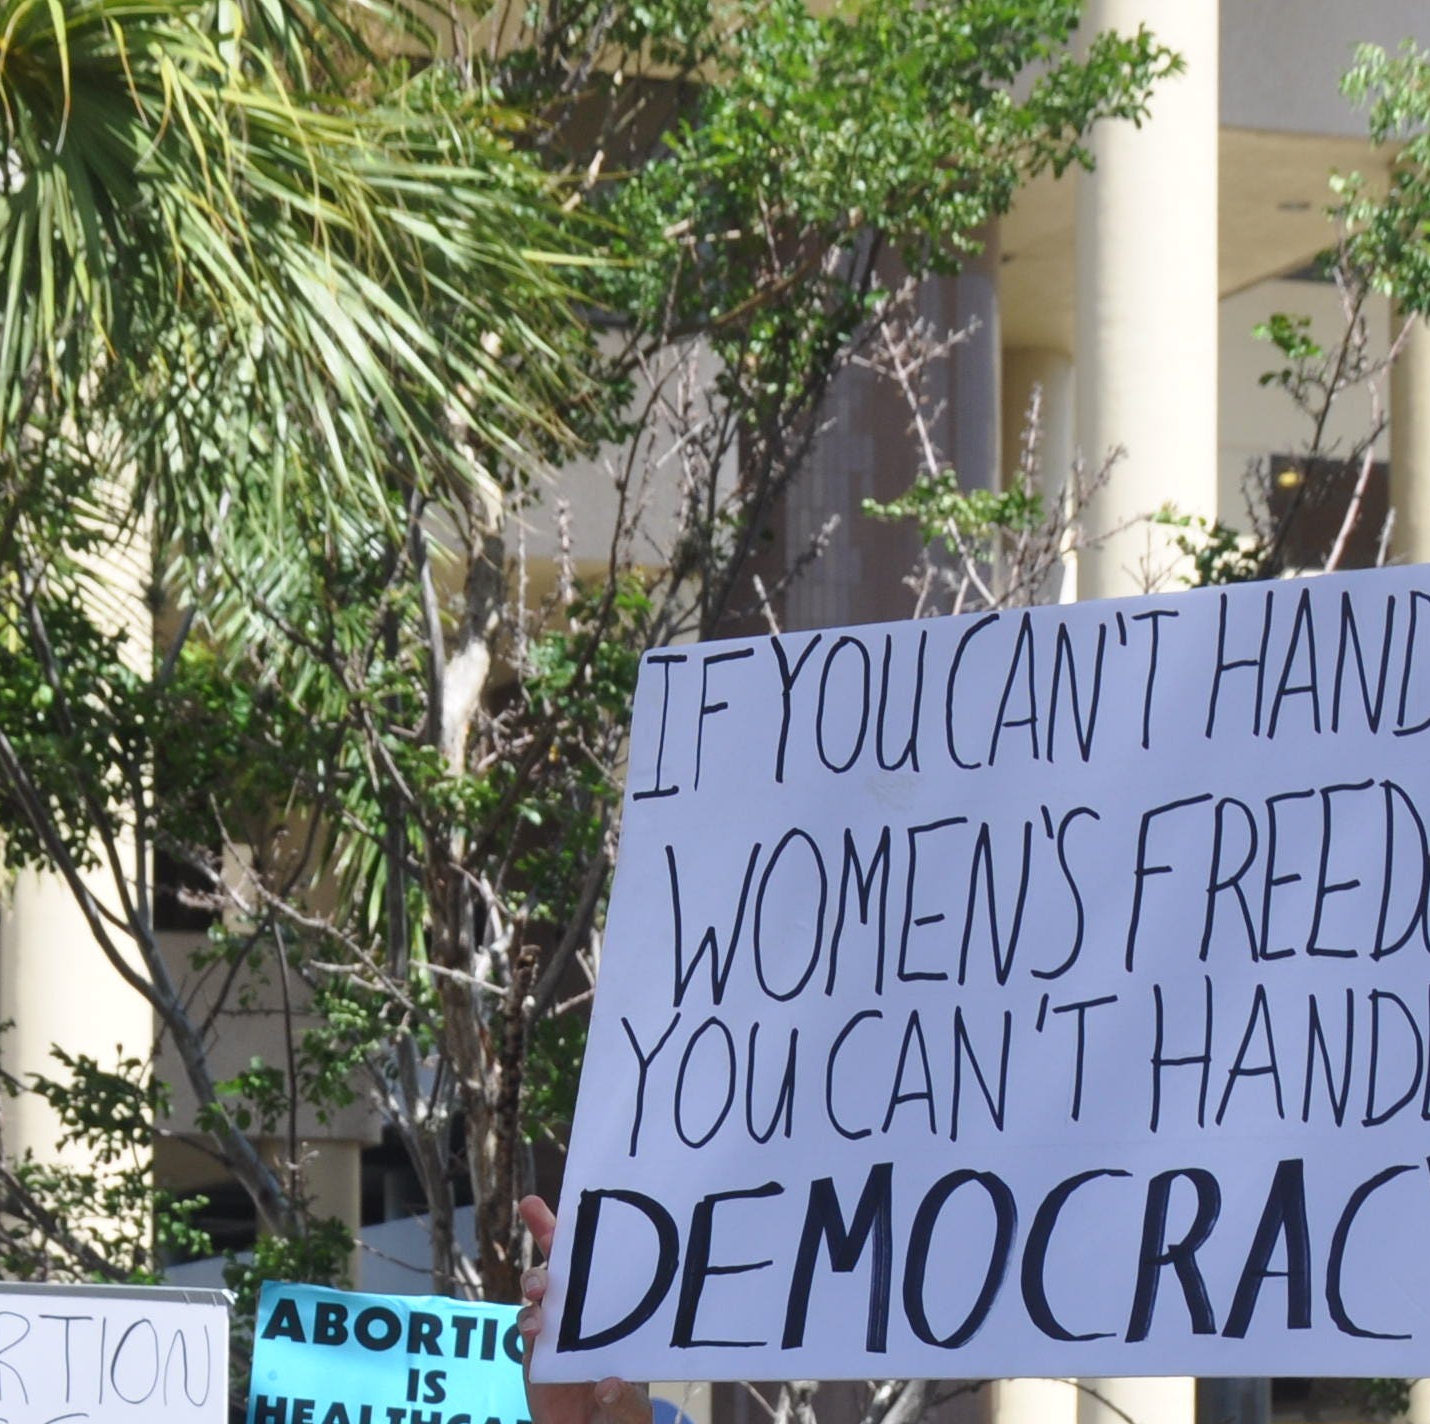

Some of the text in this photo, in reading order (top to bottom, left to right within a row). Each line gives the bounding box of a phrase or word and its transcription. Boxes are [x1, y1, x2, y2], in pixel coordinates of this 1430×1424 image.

[633, 648, 754, 800] IF
[771, 629, 928, 781] YOU
[947, 610, 1179, 769] CAN'T
[665, 805, 1099, 1006] WOMEN'S
[622, 1012, 799, 1156] YOU
[825, 994, 1118, 1140] CAN'T
[261, 1298, 524, 1365] ABORTI
[406, 1368, 447, 1404] IS
